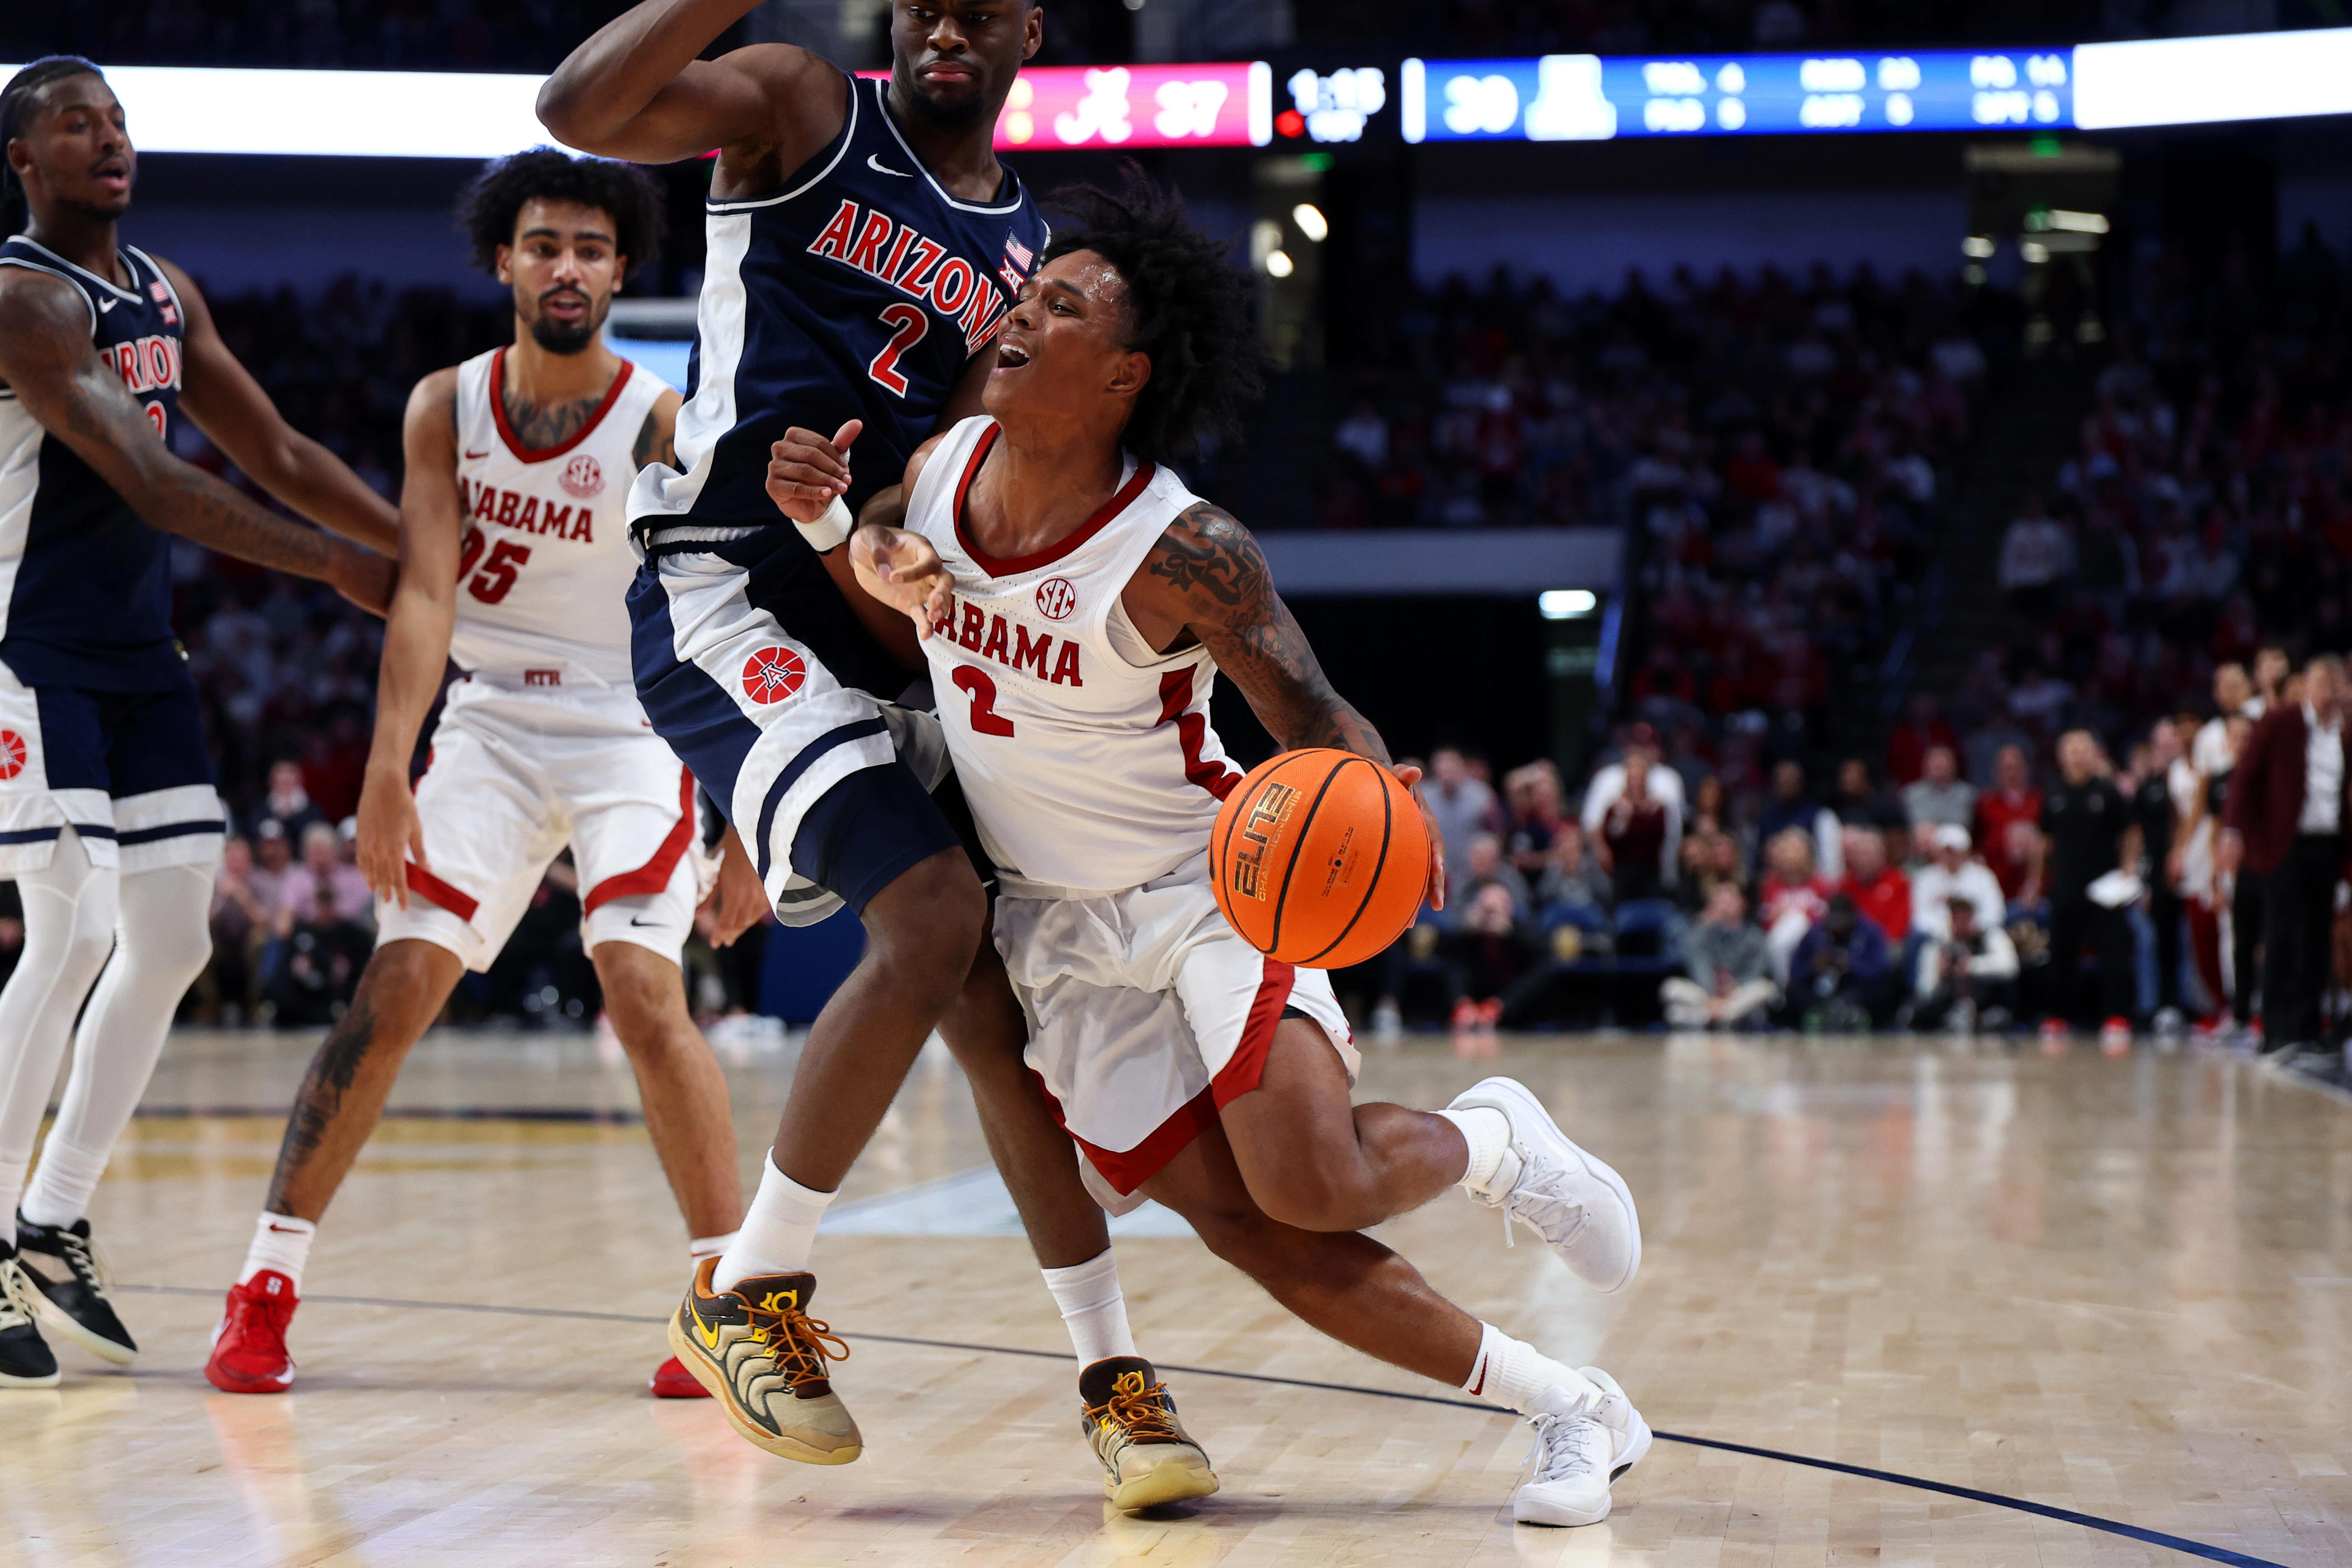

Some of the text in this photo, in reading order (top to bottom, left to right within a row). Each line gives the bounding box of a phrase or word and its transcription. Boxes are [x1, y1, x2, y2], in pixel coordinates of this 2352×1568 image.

[868, 303, 929, 399] 2
[460, 475, 594, 543] ABAMA
[934, 593, 1083, 687] ABAMA
[1036, 578, 1076, 619] SEC
[952, 664, 1014, 738] 2
[1234, 781, 1295, 899] ELITE
[1259, 790, 1302, 901] CHAMPIONSHIP
